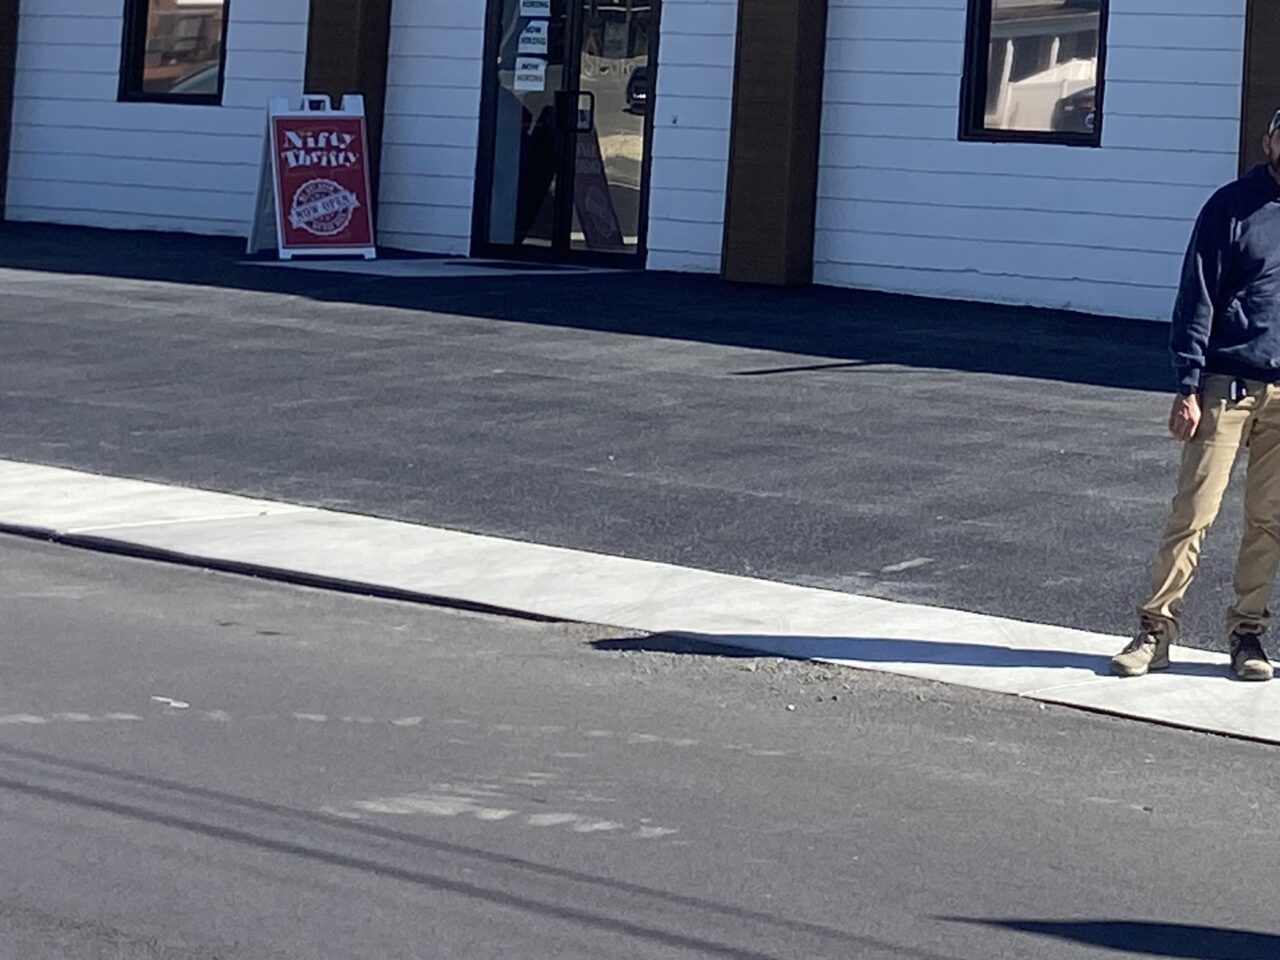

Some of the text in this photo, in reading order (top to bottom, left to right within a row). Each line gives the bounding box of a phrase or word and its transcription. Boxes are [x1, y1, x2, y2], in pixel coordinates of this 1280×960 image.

[283, 130, 357, 149] Nifty
[281, 149, 361, 168] Thrifty
[295, 193, 350, 220] NOW OPEN
